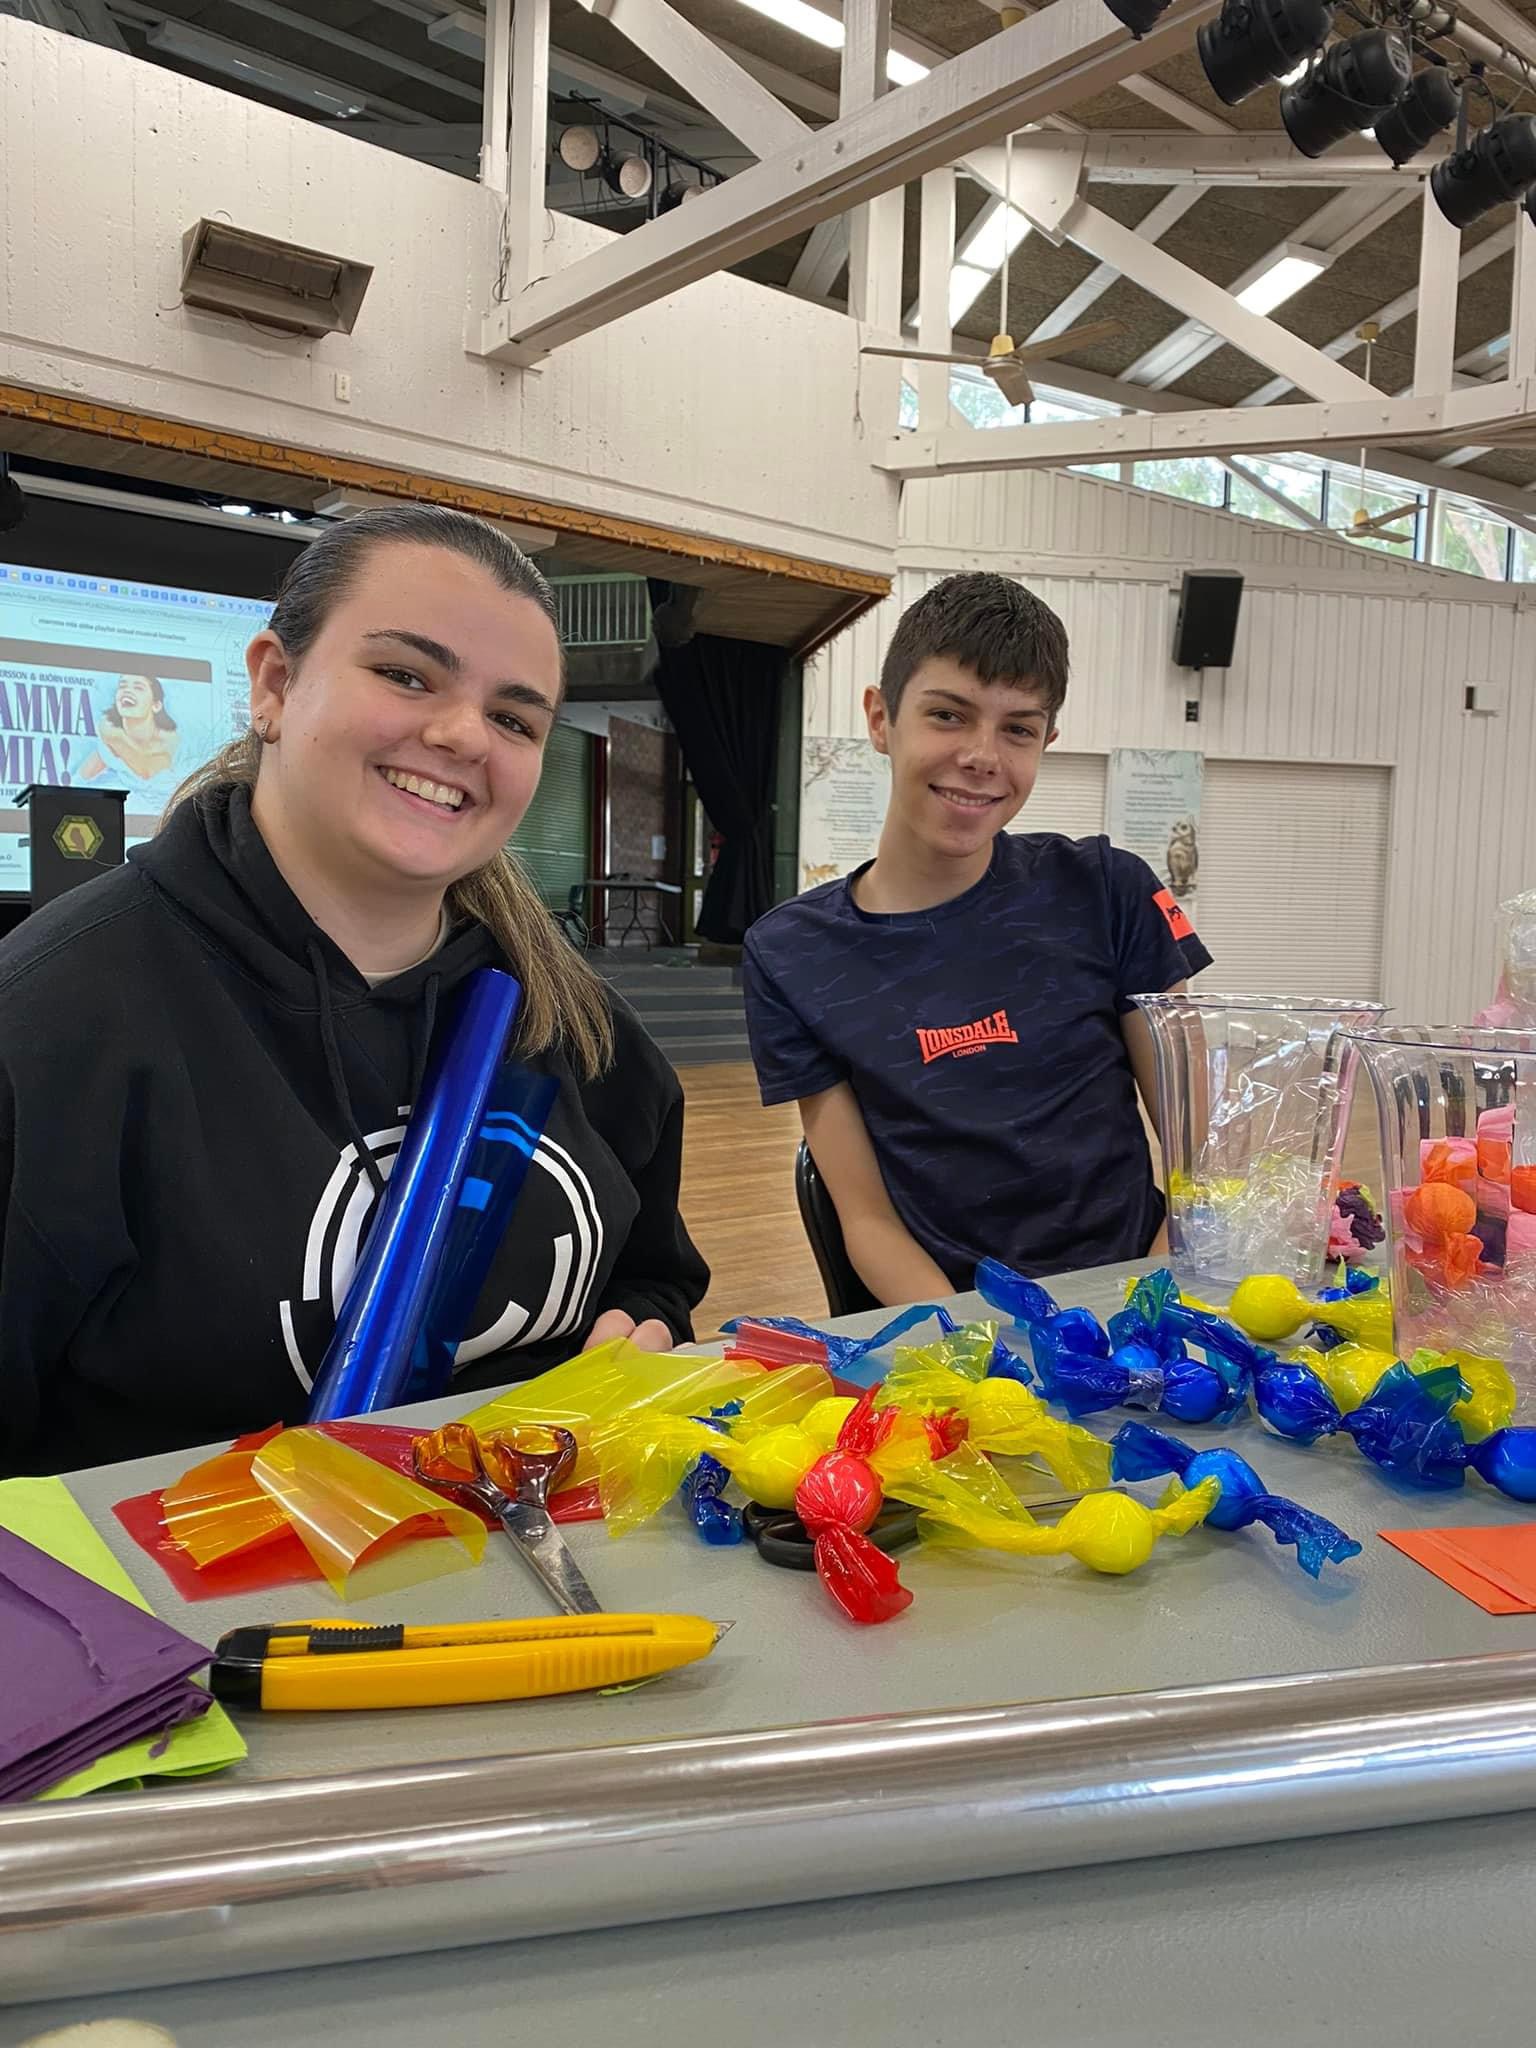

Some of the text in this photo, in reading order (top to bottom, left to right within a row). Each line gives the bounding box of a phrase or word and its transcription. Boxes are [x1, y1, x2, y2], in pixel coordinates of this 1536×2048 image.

[30, 672, 36, 681] &
[0, 681, 98, 737] AMMA
[0, 734, 71, 786] MIA!
[916, 1009, 1018, 1064] LONSDALE
[952, 1044, 987, 1058] LONDON
